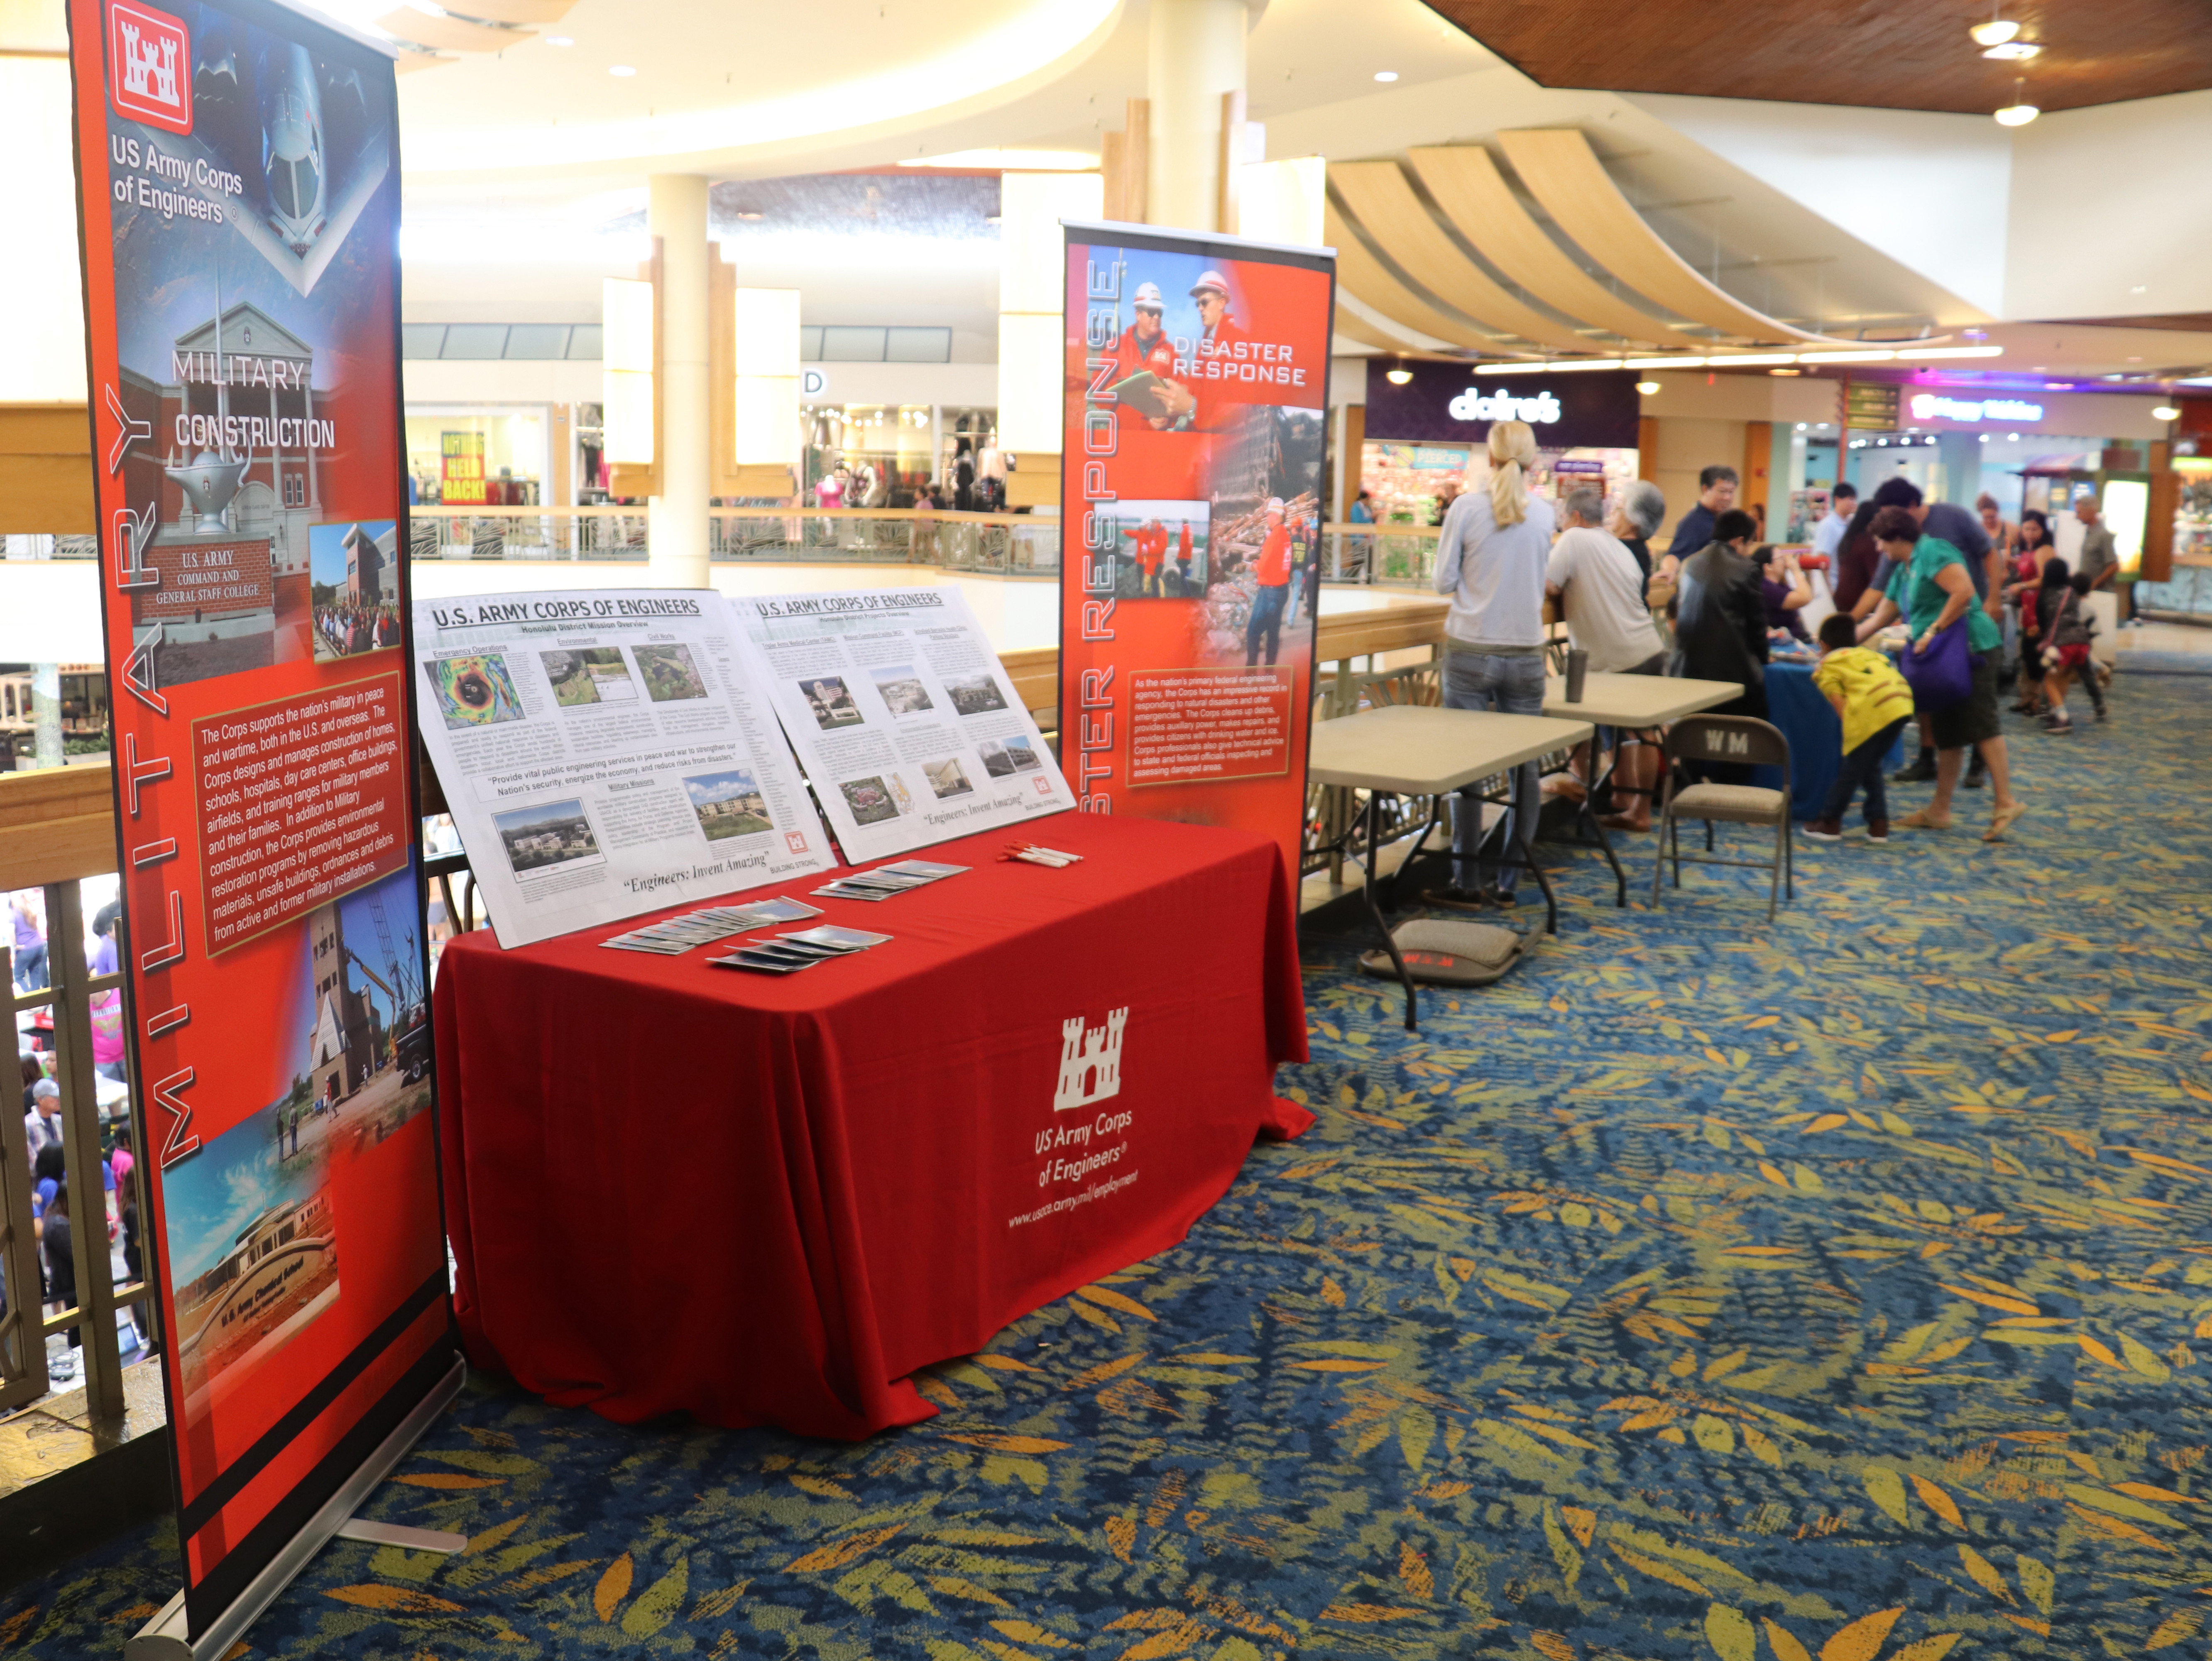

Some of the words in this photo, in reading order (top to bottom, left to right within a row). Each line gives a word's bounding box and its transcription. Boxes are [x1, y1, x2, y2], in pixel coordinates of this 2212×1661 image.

[112, 134, 140, 167] US
[145, 145, 191, 187] Army
[196, 158, 242, 197] Corps
[114, 175, 133, 203] of
[1174, 336, 1293, 363] DISASTER
[172, 350, 304, 391] MILITARY
[1173, 358, 1307, 386] RESPONSE
[176, 414, 335, 448] CONSTRUCTION
[1083, 260, 1121, 641] RESPONSE
[447, 458, 480, 477] HELD
[443, 479, 486, 500] BACK!
[177, 571, 219, 585] COMMAND
[222, 570, 239, 581] AND
[182, 552, 198, 568] U.S.
[203, 550, 233, 566] ARMY
[156, 590, 196, 604] GENERAL
[198, 588, 221, 600] STAFF
[224, 584, 259, 598] COLLEGE
[432, 608, 474, 626] U.S.
[478, 603, 529, 623] ARMY
[534, 600, 591, 618] CORPS
[593, 600, 614, 615] OF
[617, 598, 700, 615] ENGINEERS
[756, 602, 784, 617] U.S.
[788, 599, 820, 614] ARMY
[822, 597, 864, 611] CORPS
[864, 595, 880, 609] OF
[882, 593, 942, 606] ENGINEERS
[521, 624, 557, 633] Honolulu
[558, 623, 585, 631] District
[557, 637, 597, 645] Environmental
[433, 648, 470, 658] Emergency
[472, 644, 507, 654] Operations
[201, 728, 219, 744] The
[221, 723, 247, 739] Corps
[250, 712, 284, 733] supports
[286, 708, 298, 723] the
[300, 699, 328, 718] nation’s
[330, 695, 355, 710] military
[357, 693, 363, 703] in
[365, 688, 384, 705] peace
[203, 748, 220, 767] and
[222, 742, 258, 761] wartime,
[260, 733, 278, 750] both
[280, 731, 287, 745] in
[289, 728, 301, 742] the
[303, 722, 319, 738] U.S.
[321, 717, 335, 733] and
[336, 711, 369, 728] overseas.
[373, 705, 385, 718] The
[105, 383, 202, 1169] MILITARY
[204, 771, 231, 789] Corps
[233, 761, 265, 780] designs
[267, 752, 282, 770] and
[284, 745, 319, 764] manages
[321, 732, 363, 753] construction
[365, 725, 371, 740] of
[372, 722, 394, 737] homes,
[206, 788, 242, 811] schools,
[244, 775, 282, 799] hospitals,
[284, 771, 298, 786] day
[300, 766, 316, 780] care
[318, 757, 346, 774] centers,
[348, 749, 367, 764] office
[368, 740, 397, 758] buildings,
[487, 772, 522, 784] “Provide
[524, 769, 540, 778] vital
[542, 765, 564, 777] public
[566, 760, 607, 772] engineering
[607, 756, 635, 765] services
[644, 752, 662, 761] peace
[696, 744, 726, 753] strengthen
[497, 783, 530, 796] Nation's
[531, 779, 563, 789] security,
[565, 774, 594, 784] energize
[608, 767, 639, 777] economy,
[641, 763, 653, 772] and
[707, 752, 735, 762] disasters.”
[207, 810, 243, 833] airfields,
[246, 801, 261, 820] and
[263, 794, 292, 813] training
[294, 785, 320, 803] ranges
[321, 779, 331, 793] for
[333, 772, 357, 789] military
[359, 761, 389, 780] members
[208, 835, 225, 855] and
[227, 829, 246, 848] their
[248, 819, 281, 840] families.
[286, 813, 294, 826] In
[295, 803, 324, 823] addition
[325, 799, 333, 811] to
[335, 791, 359, 808] Military
[210, 848, 264, 876] construction,
[265, 840, 279, 855] the
[280, 831, 303, 849] Corps
[305, 818, 336, 843] provides
[338, 797, 384, 826] environmental
[211, 871, 257, 898] restoration
[259, 855, 296, 882] programs
[298, 850, 307, 865] by
[309, 836, 342, 858] removing
[343, 821, 379, 844] hazardous
[213, 892, 254, 920] materials,
[257, 879, 284, 901] unsafe
[285, 866, 321, 889] buildings,
[322, 849, 359, 872] ordnances
[360, 839, 373, 856] and
[374, 833, 393, 850] debris
[624, 870, 689, 892] “Engineers:
[692, 862, 723, 878] Invent
[726, 850, 769, 871] Amazing”
[769, 863, 795, 874] BUILDING
[214, 923, 234, 941] from
[236, 912, 261, 931] active
[263, 901, 278, 919] and
[279, 892, 305, 911] former
[307, 879, 332, 899] military
[334, 861, 376, 887] installations.
[1035, 1128, 1053, 1154] US
[1054, 1124, 1091, 1147] Army
[1096, 1110, 1131, 1135] Corps
[1039, 1160, 1052, 1187] of
[1009, 1169, 1138, 1227] www.usace.army.mil/employment
